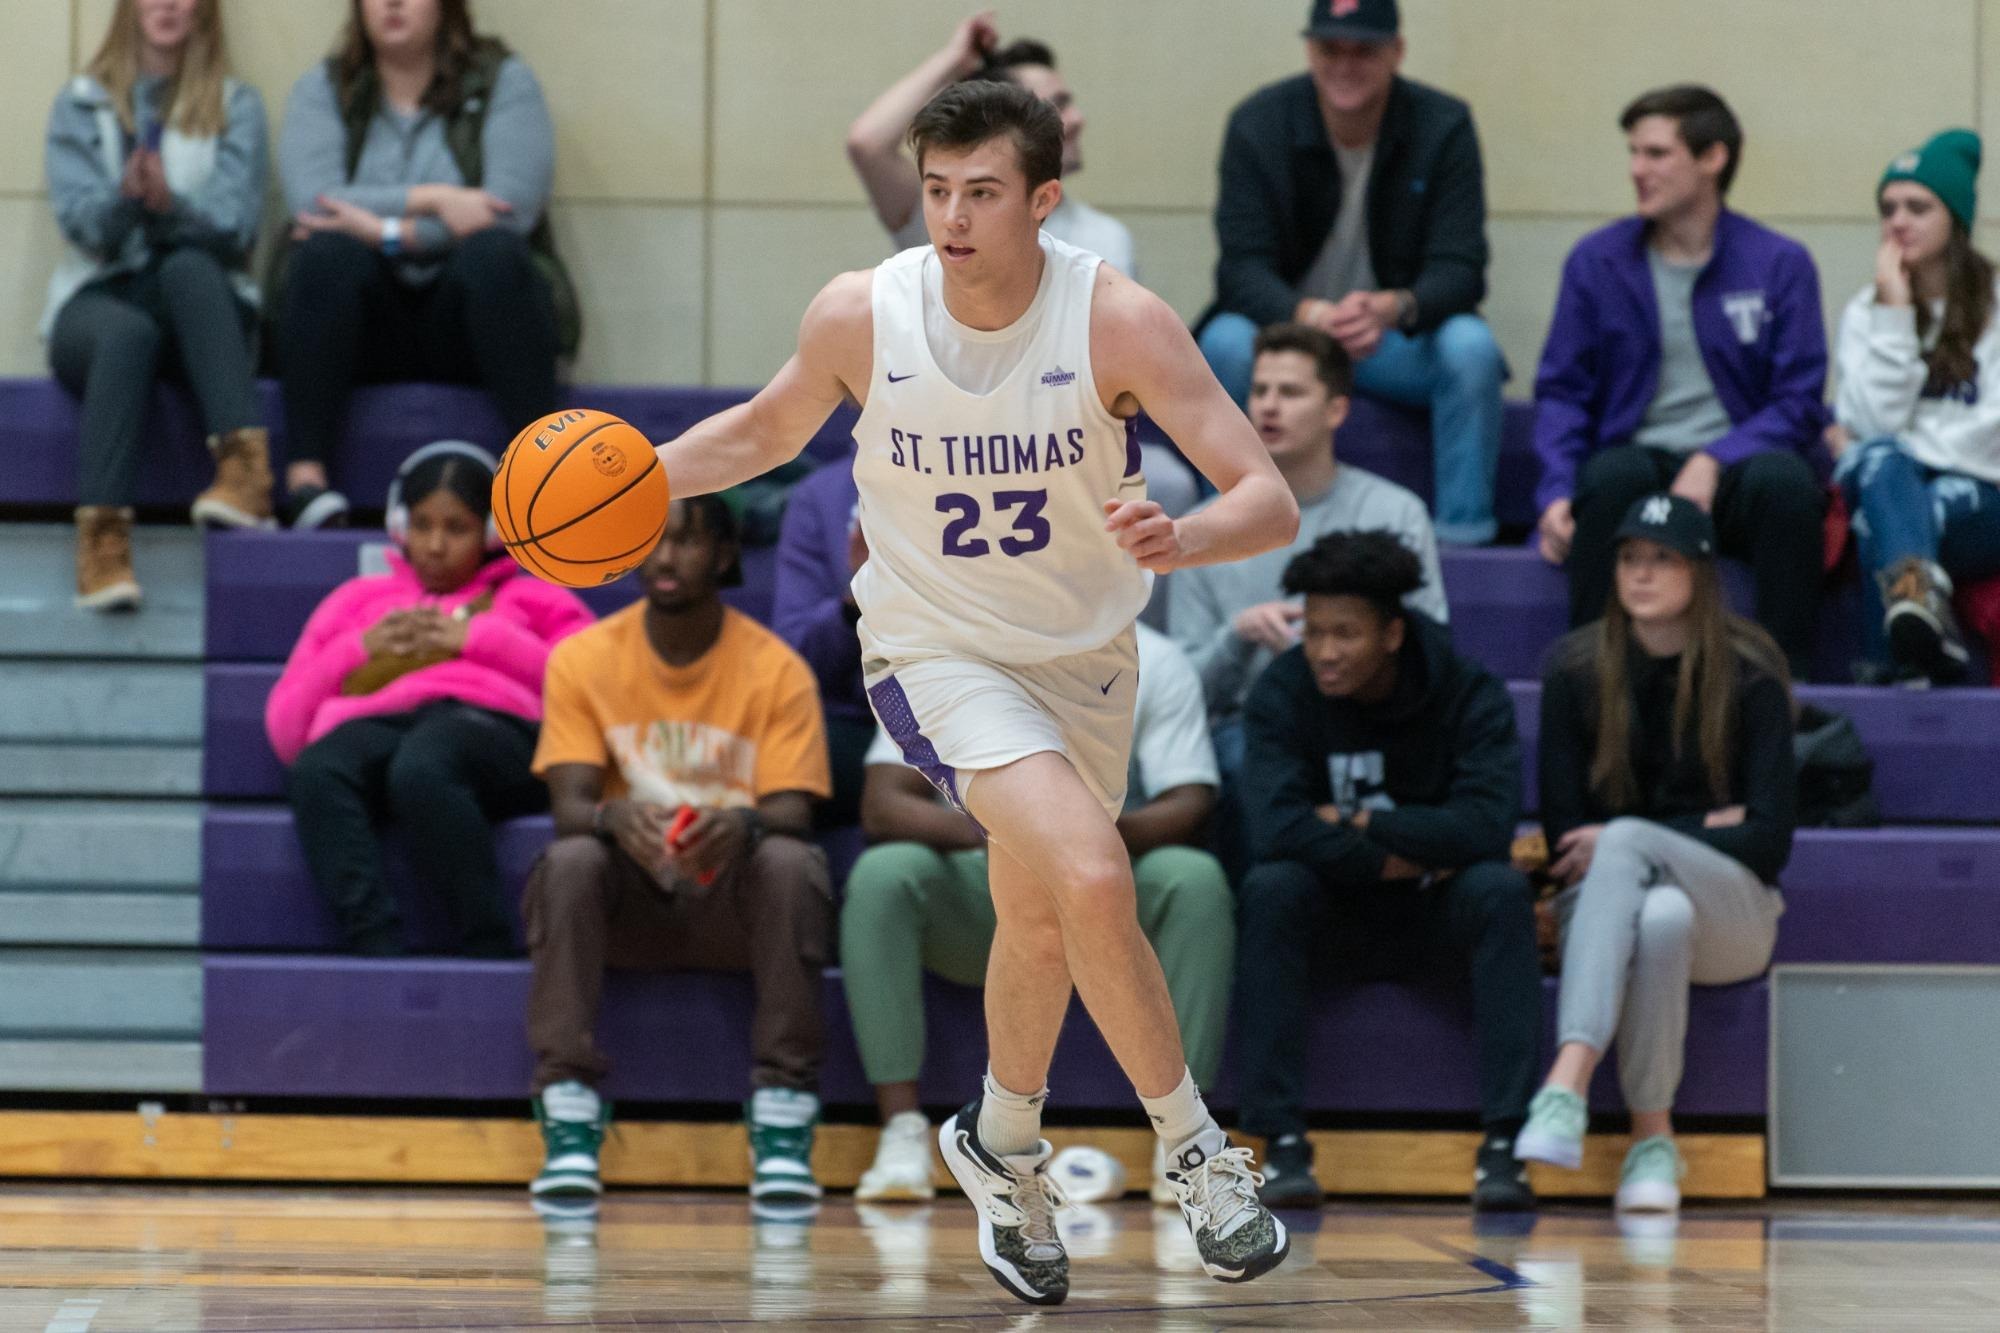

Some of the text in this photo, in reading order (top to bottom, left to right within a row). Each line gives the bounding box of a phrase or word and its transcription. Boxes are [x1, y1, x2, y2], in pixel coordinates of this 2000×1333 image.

[1041, 372, 1076, 384] SUMMIT
[891, 427, 1084, 476] ST. THOMAS
[935, 488, 1051, 557] 23
